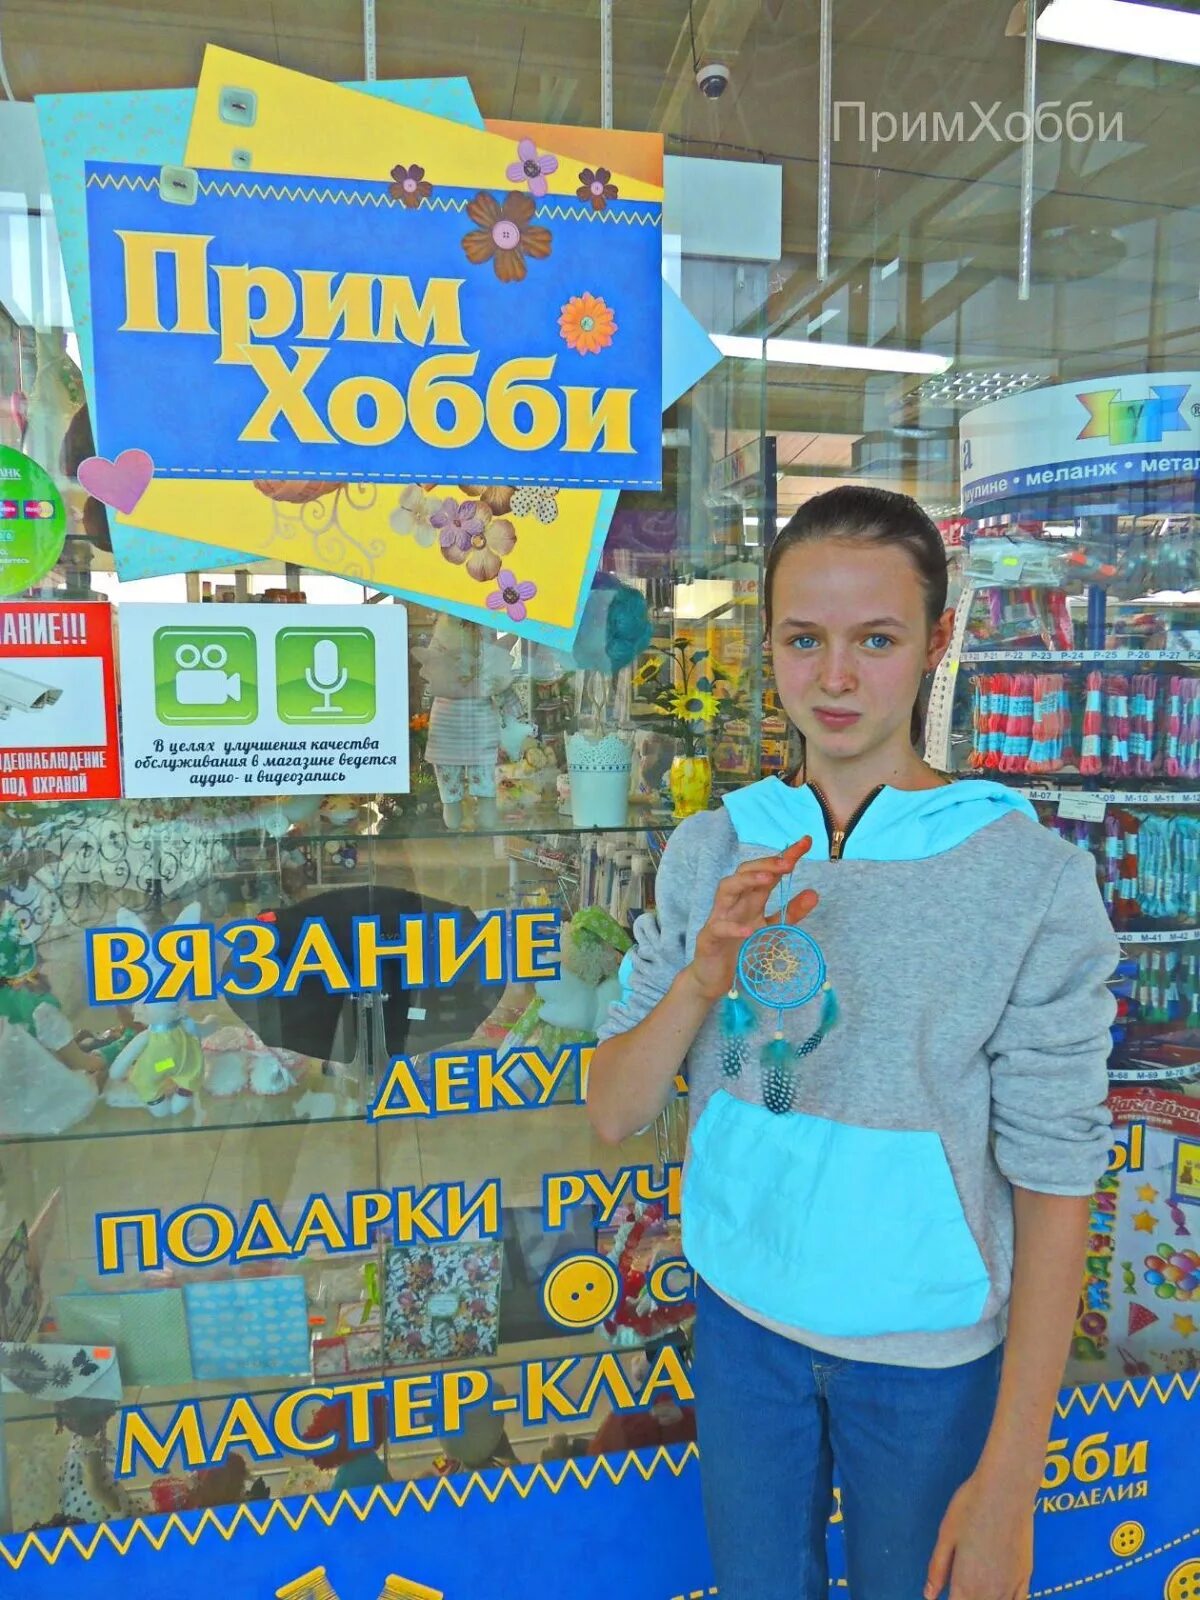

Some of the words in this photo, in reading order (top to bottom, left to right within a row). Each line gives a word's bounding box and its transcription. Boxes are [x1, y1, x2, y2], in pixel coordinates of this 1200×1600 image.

[114, 229, 466, 365] Прим
[237, 343, 638, 455] Хобби
[1026, 459, 1117, 487] меланж
[0, 613, 87, 645] АНИЕ!!!
[153, 738, 164, 752] В
[169, 741, 215, 755] целях
[223, 739, 307, 756] улучшения
[310, 736, 380, 751] качества
[134, 755, 247, 770] обслуживания
[251, 755, 259, 767] в
[262, 755, 335, 772] магазине
[338, 754, 397, 772] ведется
[189, 771, 240, 787] аудио-
[245, 773, 253, 783] и
[257, 769, 346, 787] видеозапись
[2, 776, 27, 797] ПОД
[32, 773, 87, 794] ОХРАНОЙ
[89, 910, 560, 1004] ВЯЗАНИЕ
[100, 1180, 500, 1272] ПОДАРКИ
[546, 1166, 682, 1228] РУЧ
